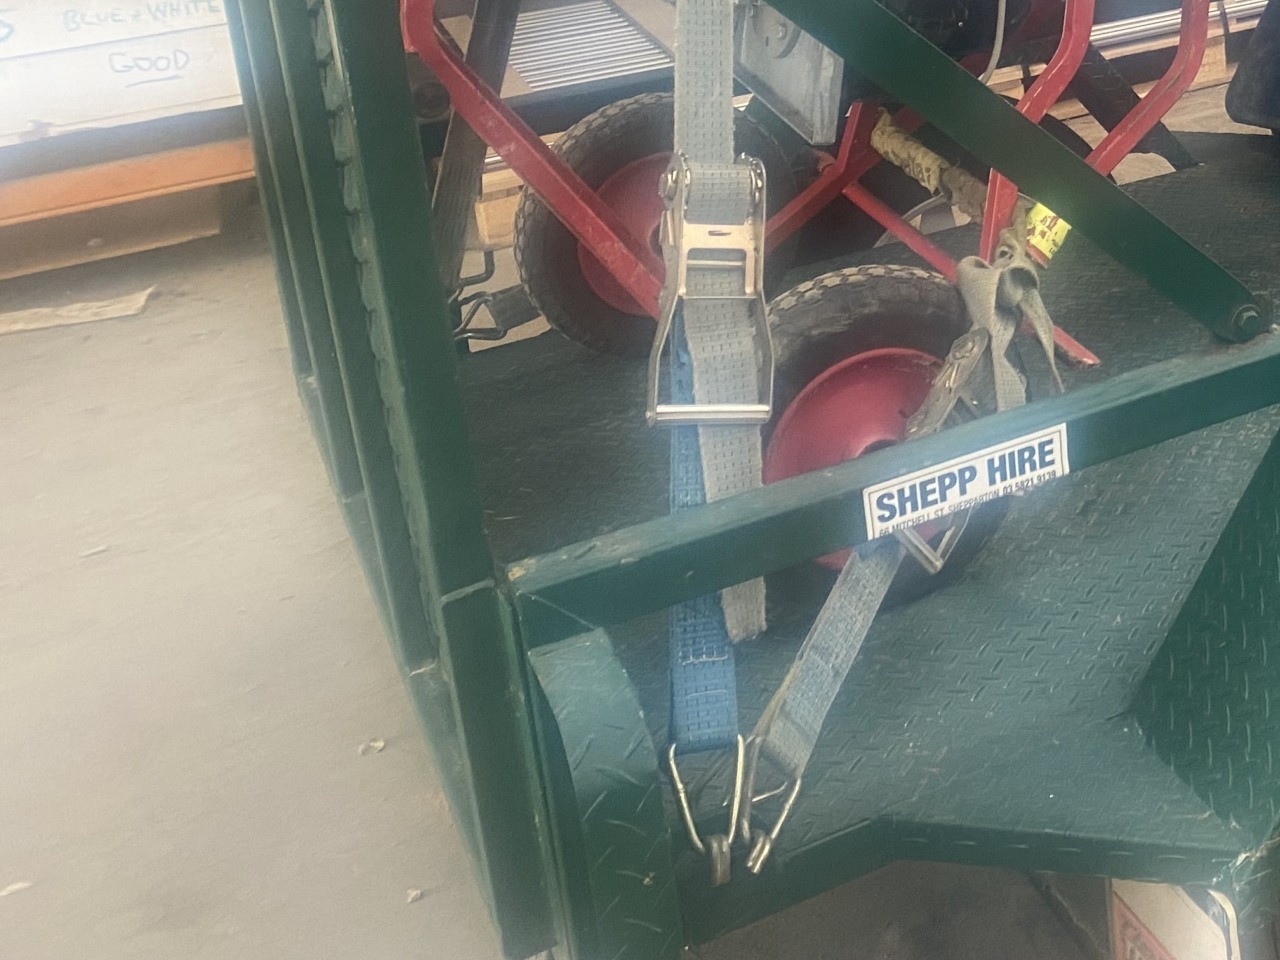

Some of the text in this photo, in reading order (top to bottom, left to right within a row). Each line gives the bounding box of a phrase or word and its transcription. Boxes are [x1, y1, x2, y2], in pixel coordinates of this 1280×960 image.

[63, 8, 124, 32] BLUE
[108, 48, 190, 73] GOOD
[876, 438, 1056, 523] SHEPP HIRE
[891, 514, 931, 534] MITCHELL
[948, 492, 1000, 515] SHEPPARTON
[1002, 485, 1013, 496] 03
[1015, 477, 1034, 492] 5821
[1036, 470, 1056, 486] 9139
